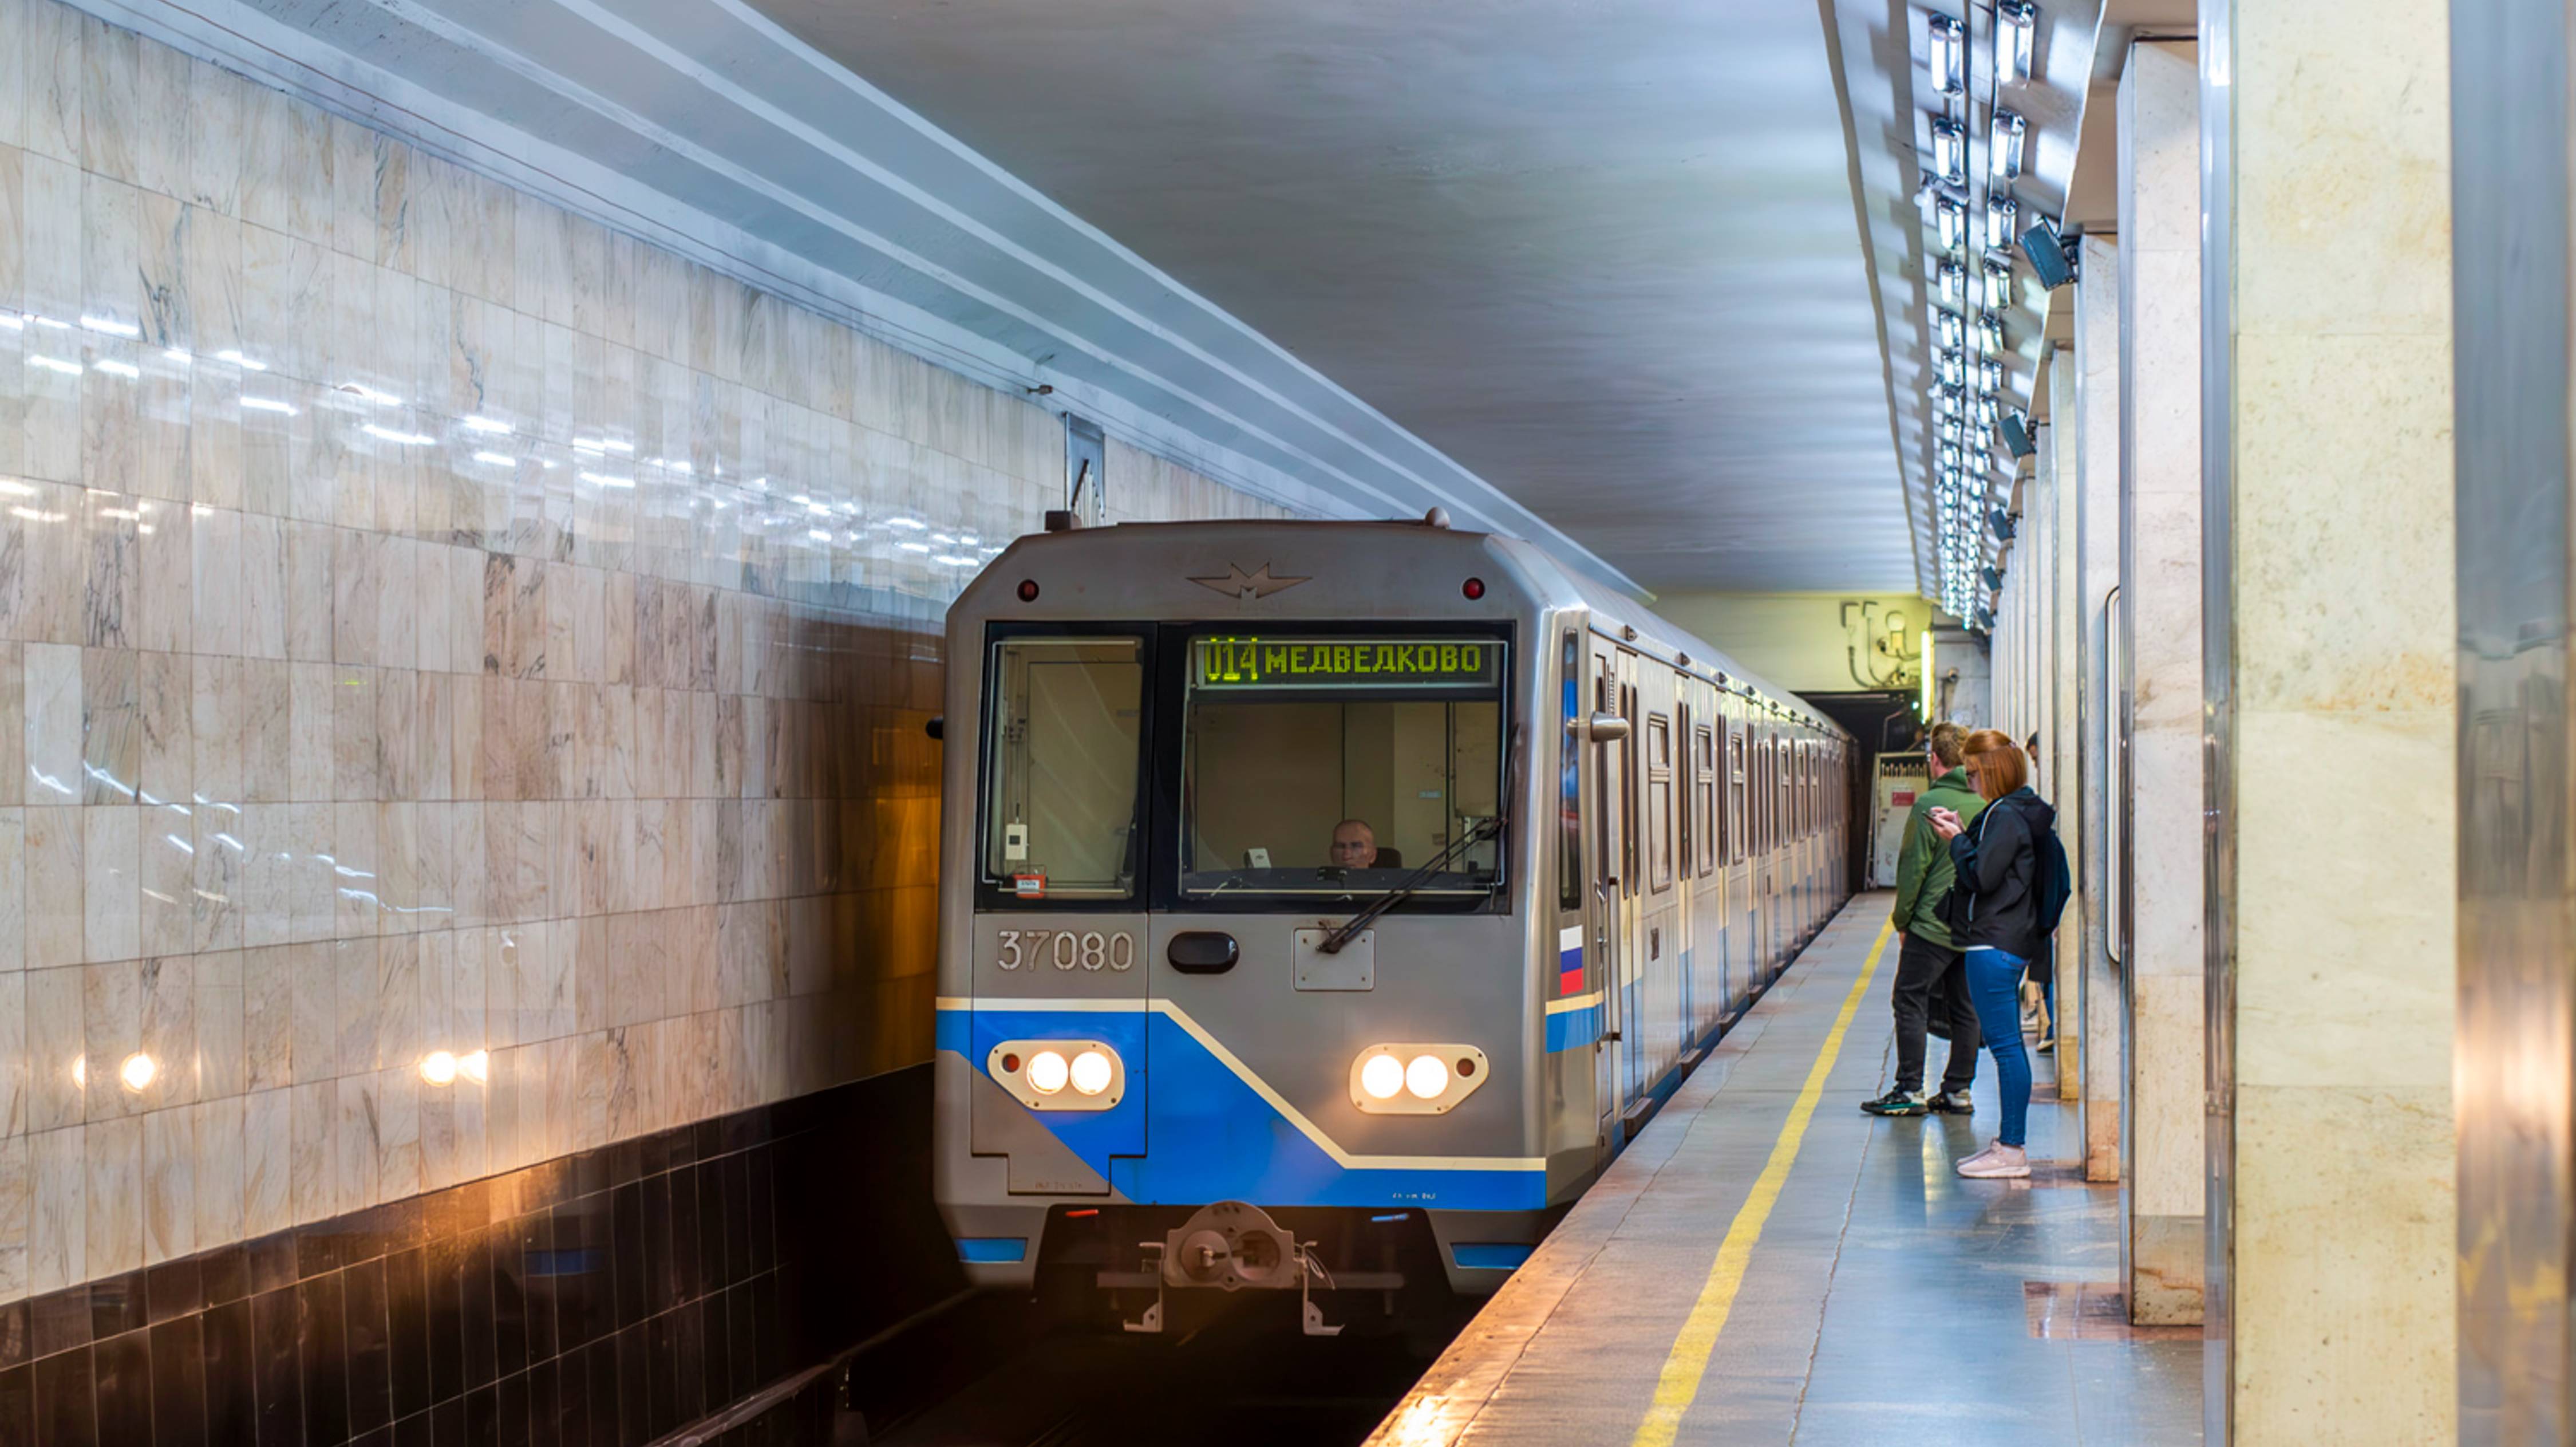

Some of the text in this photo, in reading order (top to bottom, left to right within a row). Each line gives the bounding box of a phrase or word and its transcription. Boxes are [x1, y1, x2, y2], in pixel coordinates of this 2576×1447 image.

[1204, 637, 1481, 681] 014 МЕДВЕДКОВО
[998, 931, 1133, 971] 37080
